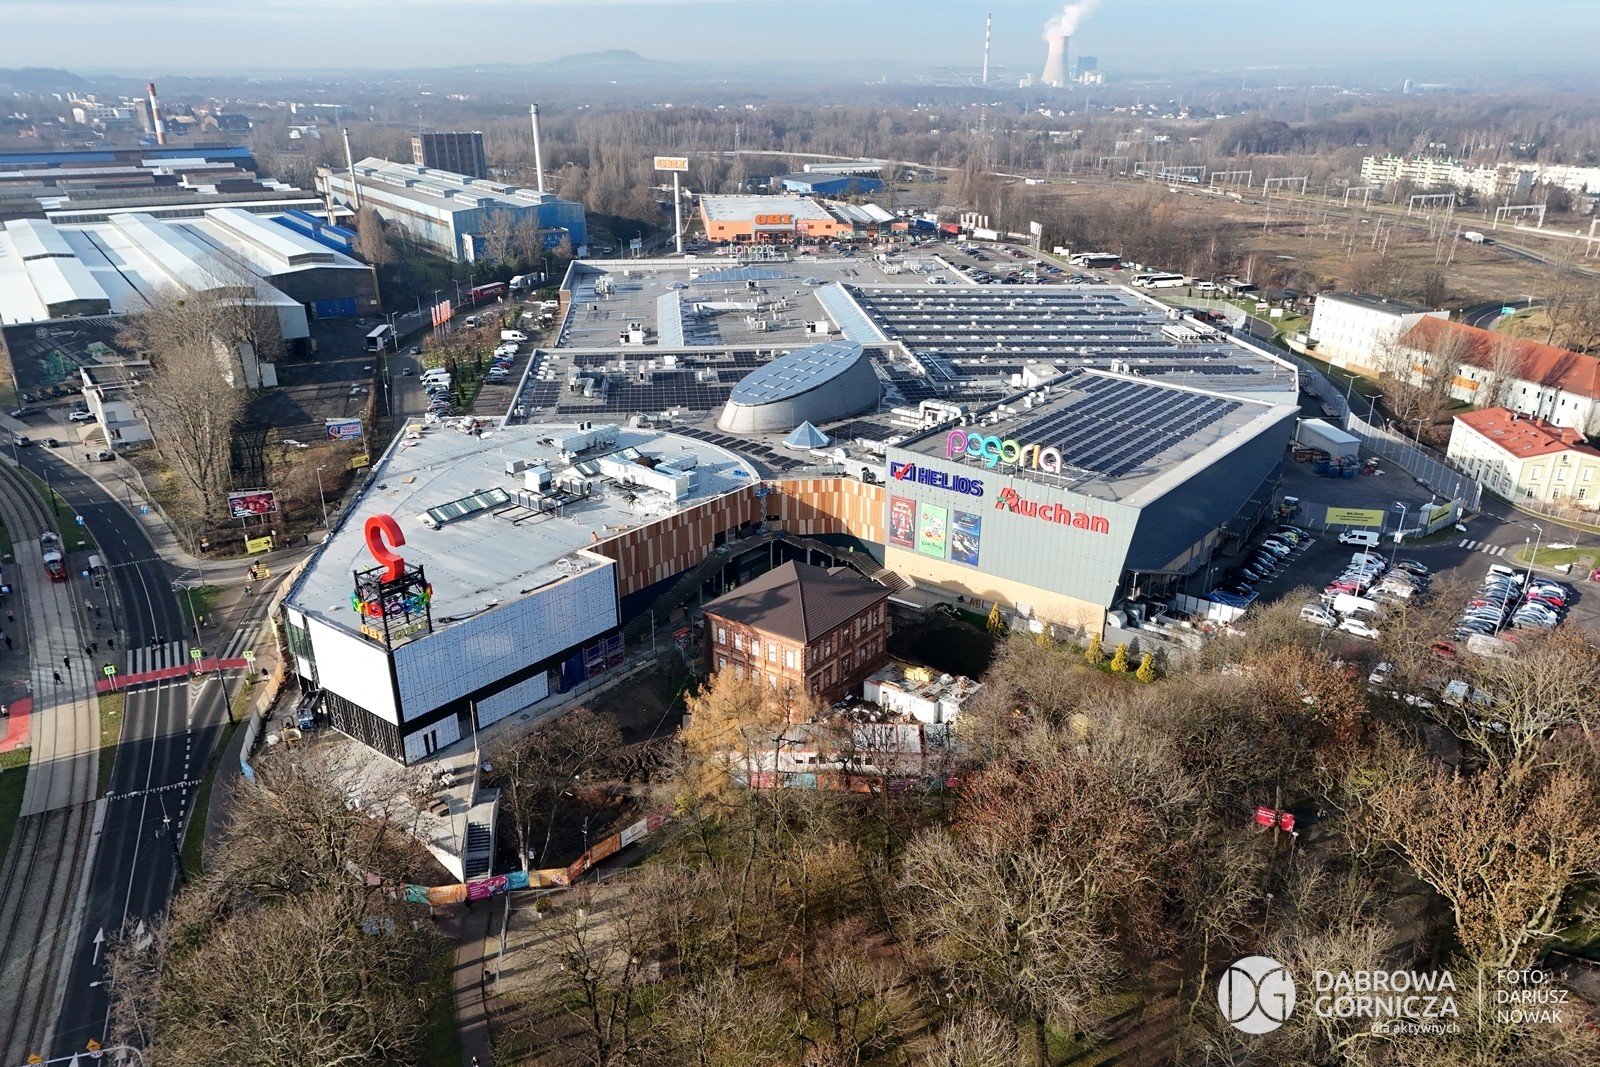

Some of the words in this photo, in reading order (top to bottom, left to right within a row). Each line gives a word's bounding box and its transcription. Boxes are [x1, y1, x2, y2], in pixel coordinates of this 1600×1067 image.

[755, 214, 792, 225] OBI
[946, 429, 1063, 474] pogoria
[917, 467, 984, 497] HELIOS
[995, 487, 1110, 534] Auchan
